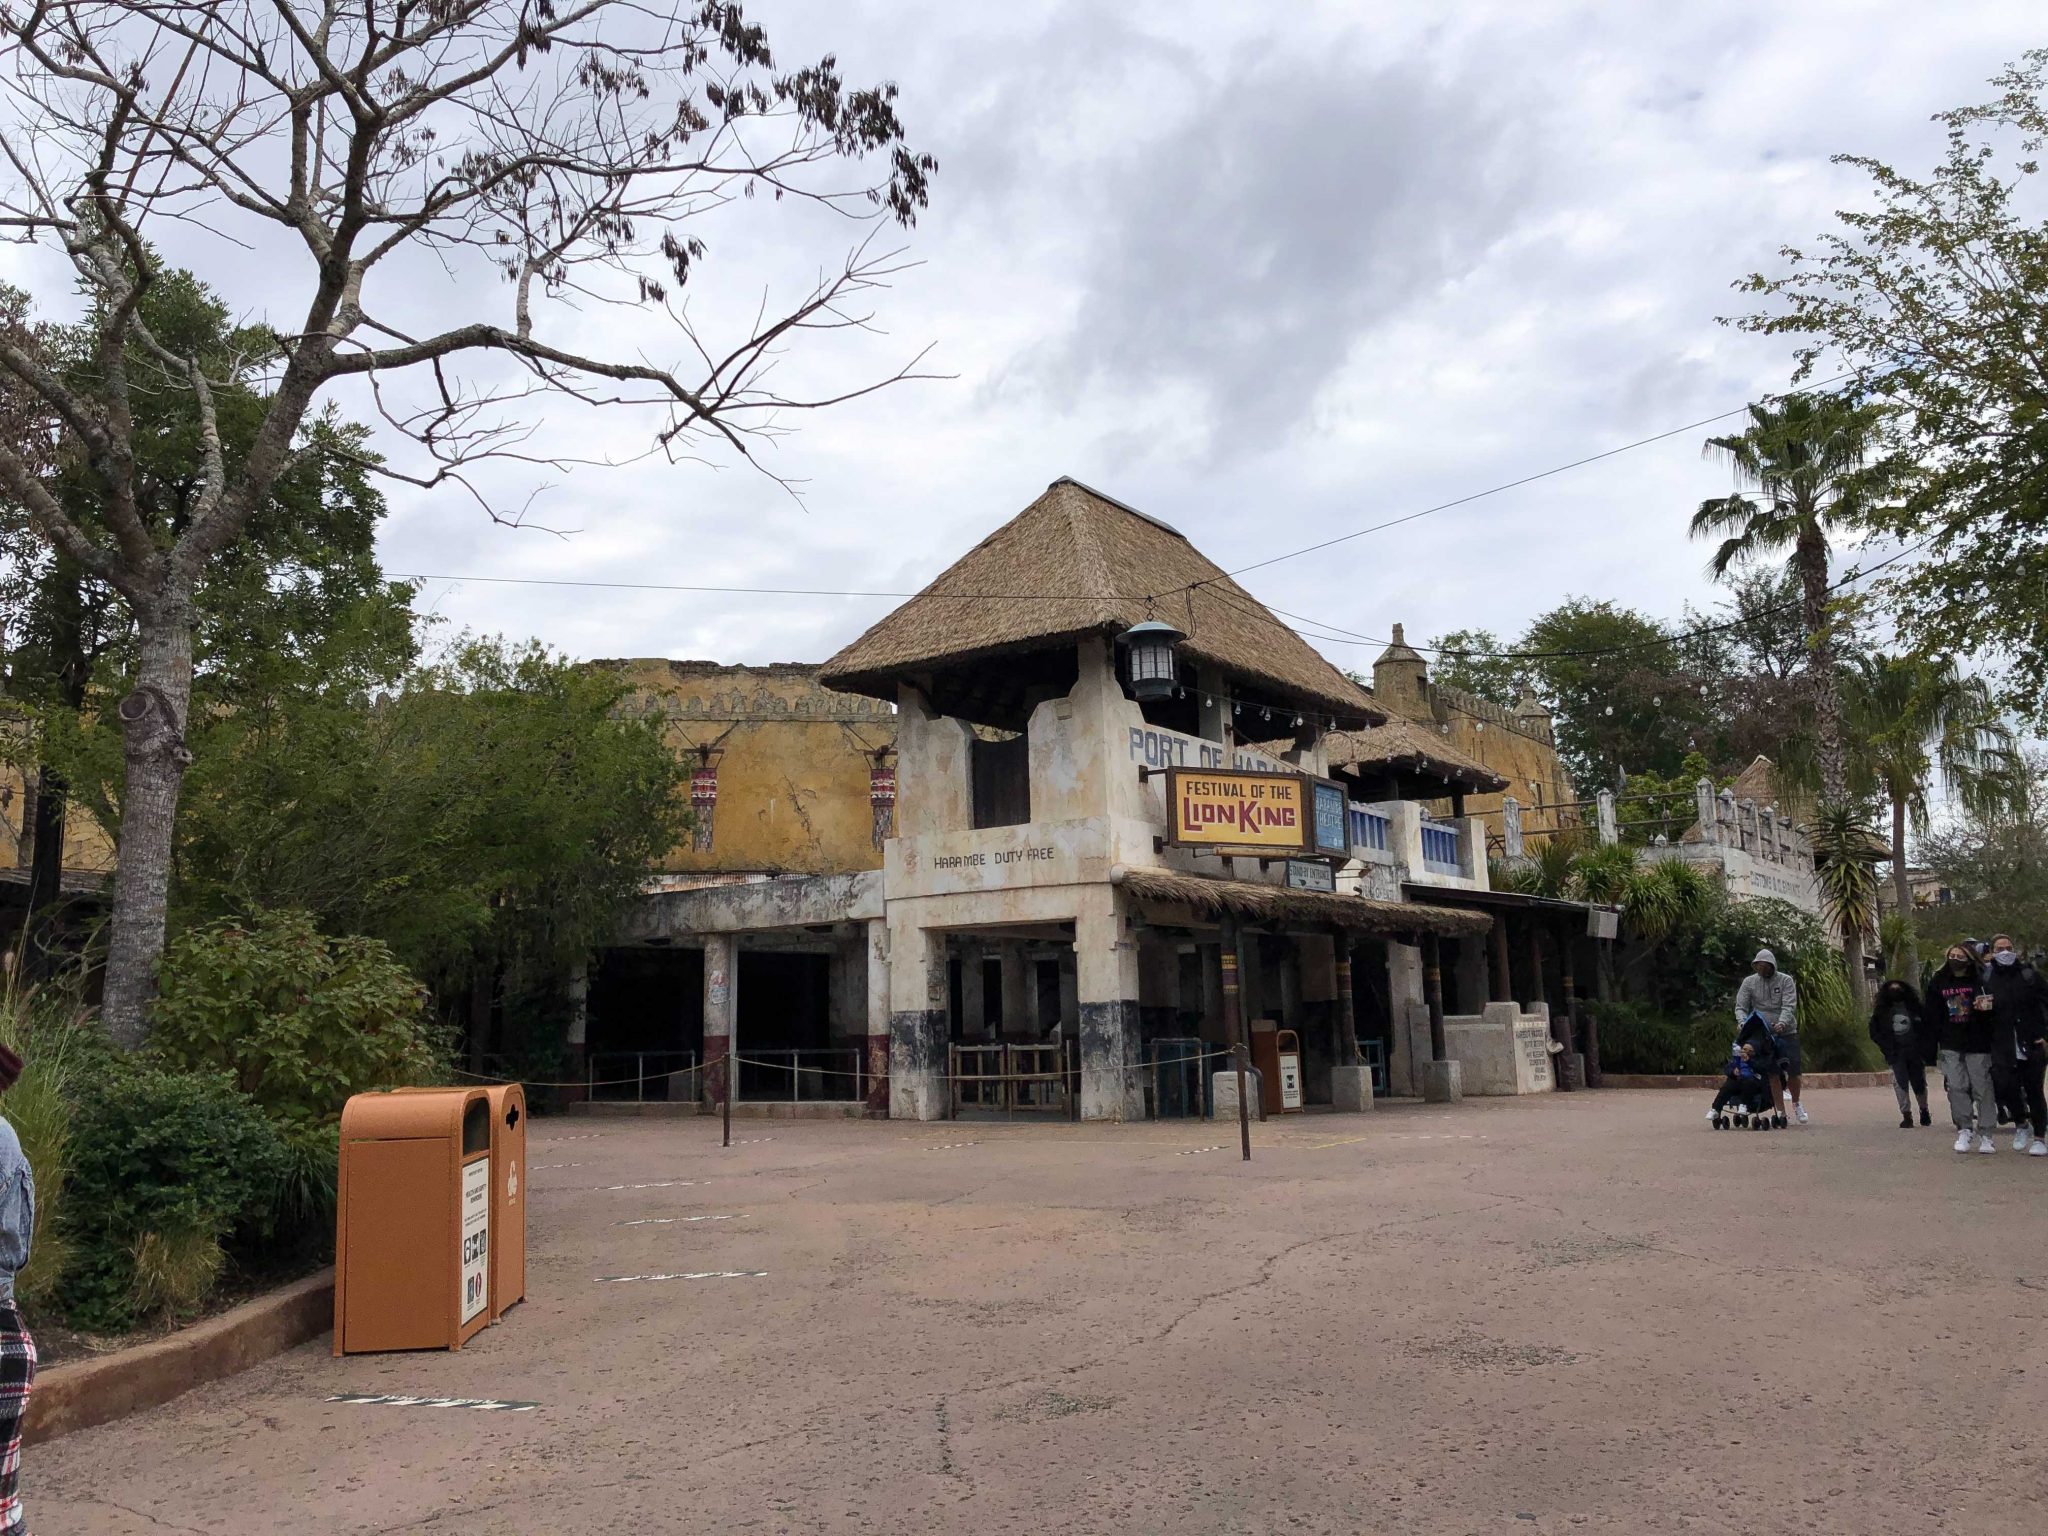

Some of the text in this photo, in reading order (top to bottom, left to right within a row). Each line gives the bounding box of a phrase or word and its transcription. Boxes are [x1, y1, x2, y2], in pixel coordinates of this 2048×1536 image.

[1129, 727, 1188, 768] PORT
[1199, 745, 1223, 768] OF
[1186, 780, 1293, 800] FESTIVAL OF THE
[1183, 796, 1296, 834] LION KING
[934, 847, 1055, 869] HARAMBE DUTY FREE
